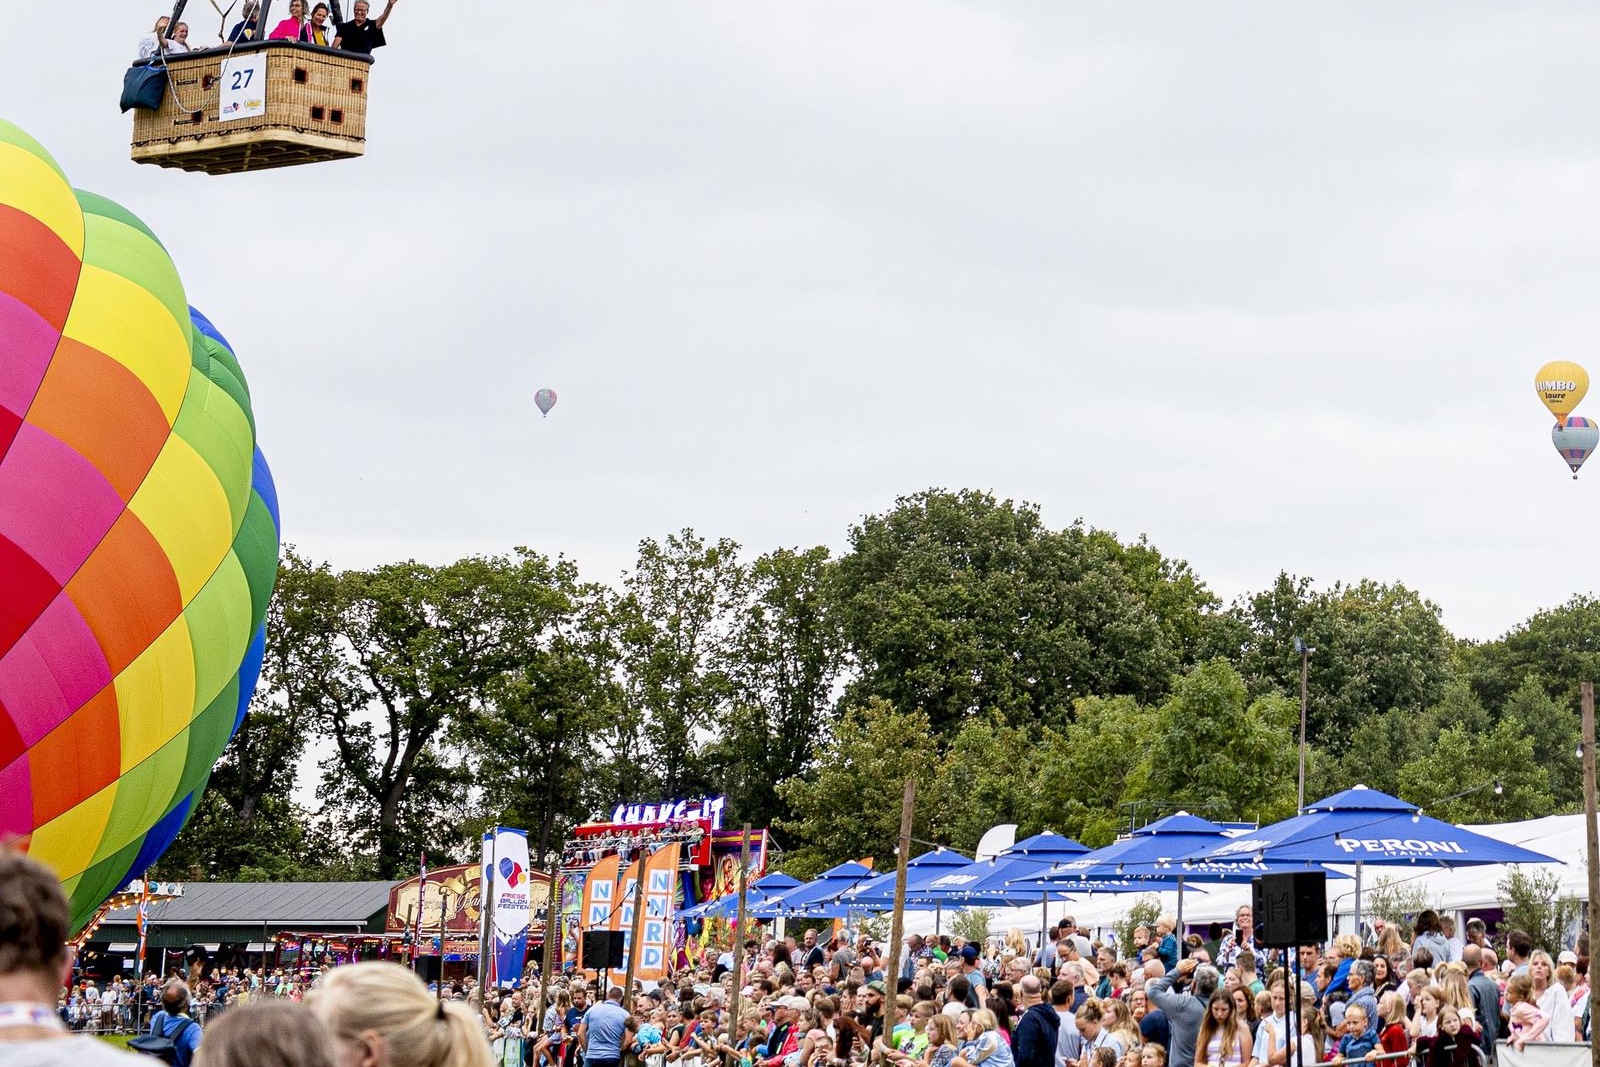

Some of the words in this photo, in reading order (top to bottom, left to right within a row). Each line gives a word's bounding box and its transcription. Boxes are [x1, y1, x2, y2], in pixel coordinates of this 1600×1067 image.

[231, 68, 254, 90] 27
[1536, 380, 1577, 392] JUMBO
[1339, 838, 1465, 853] PERONI
